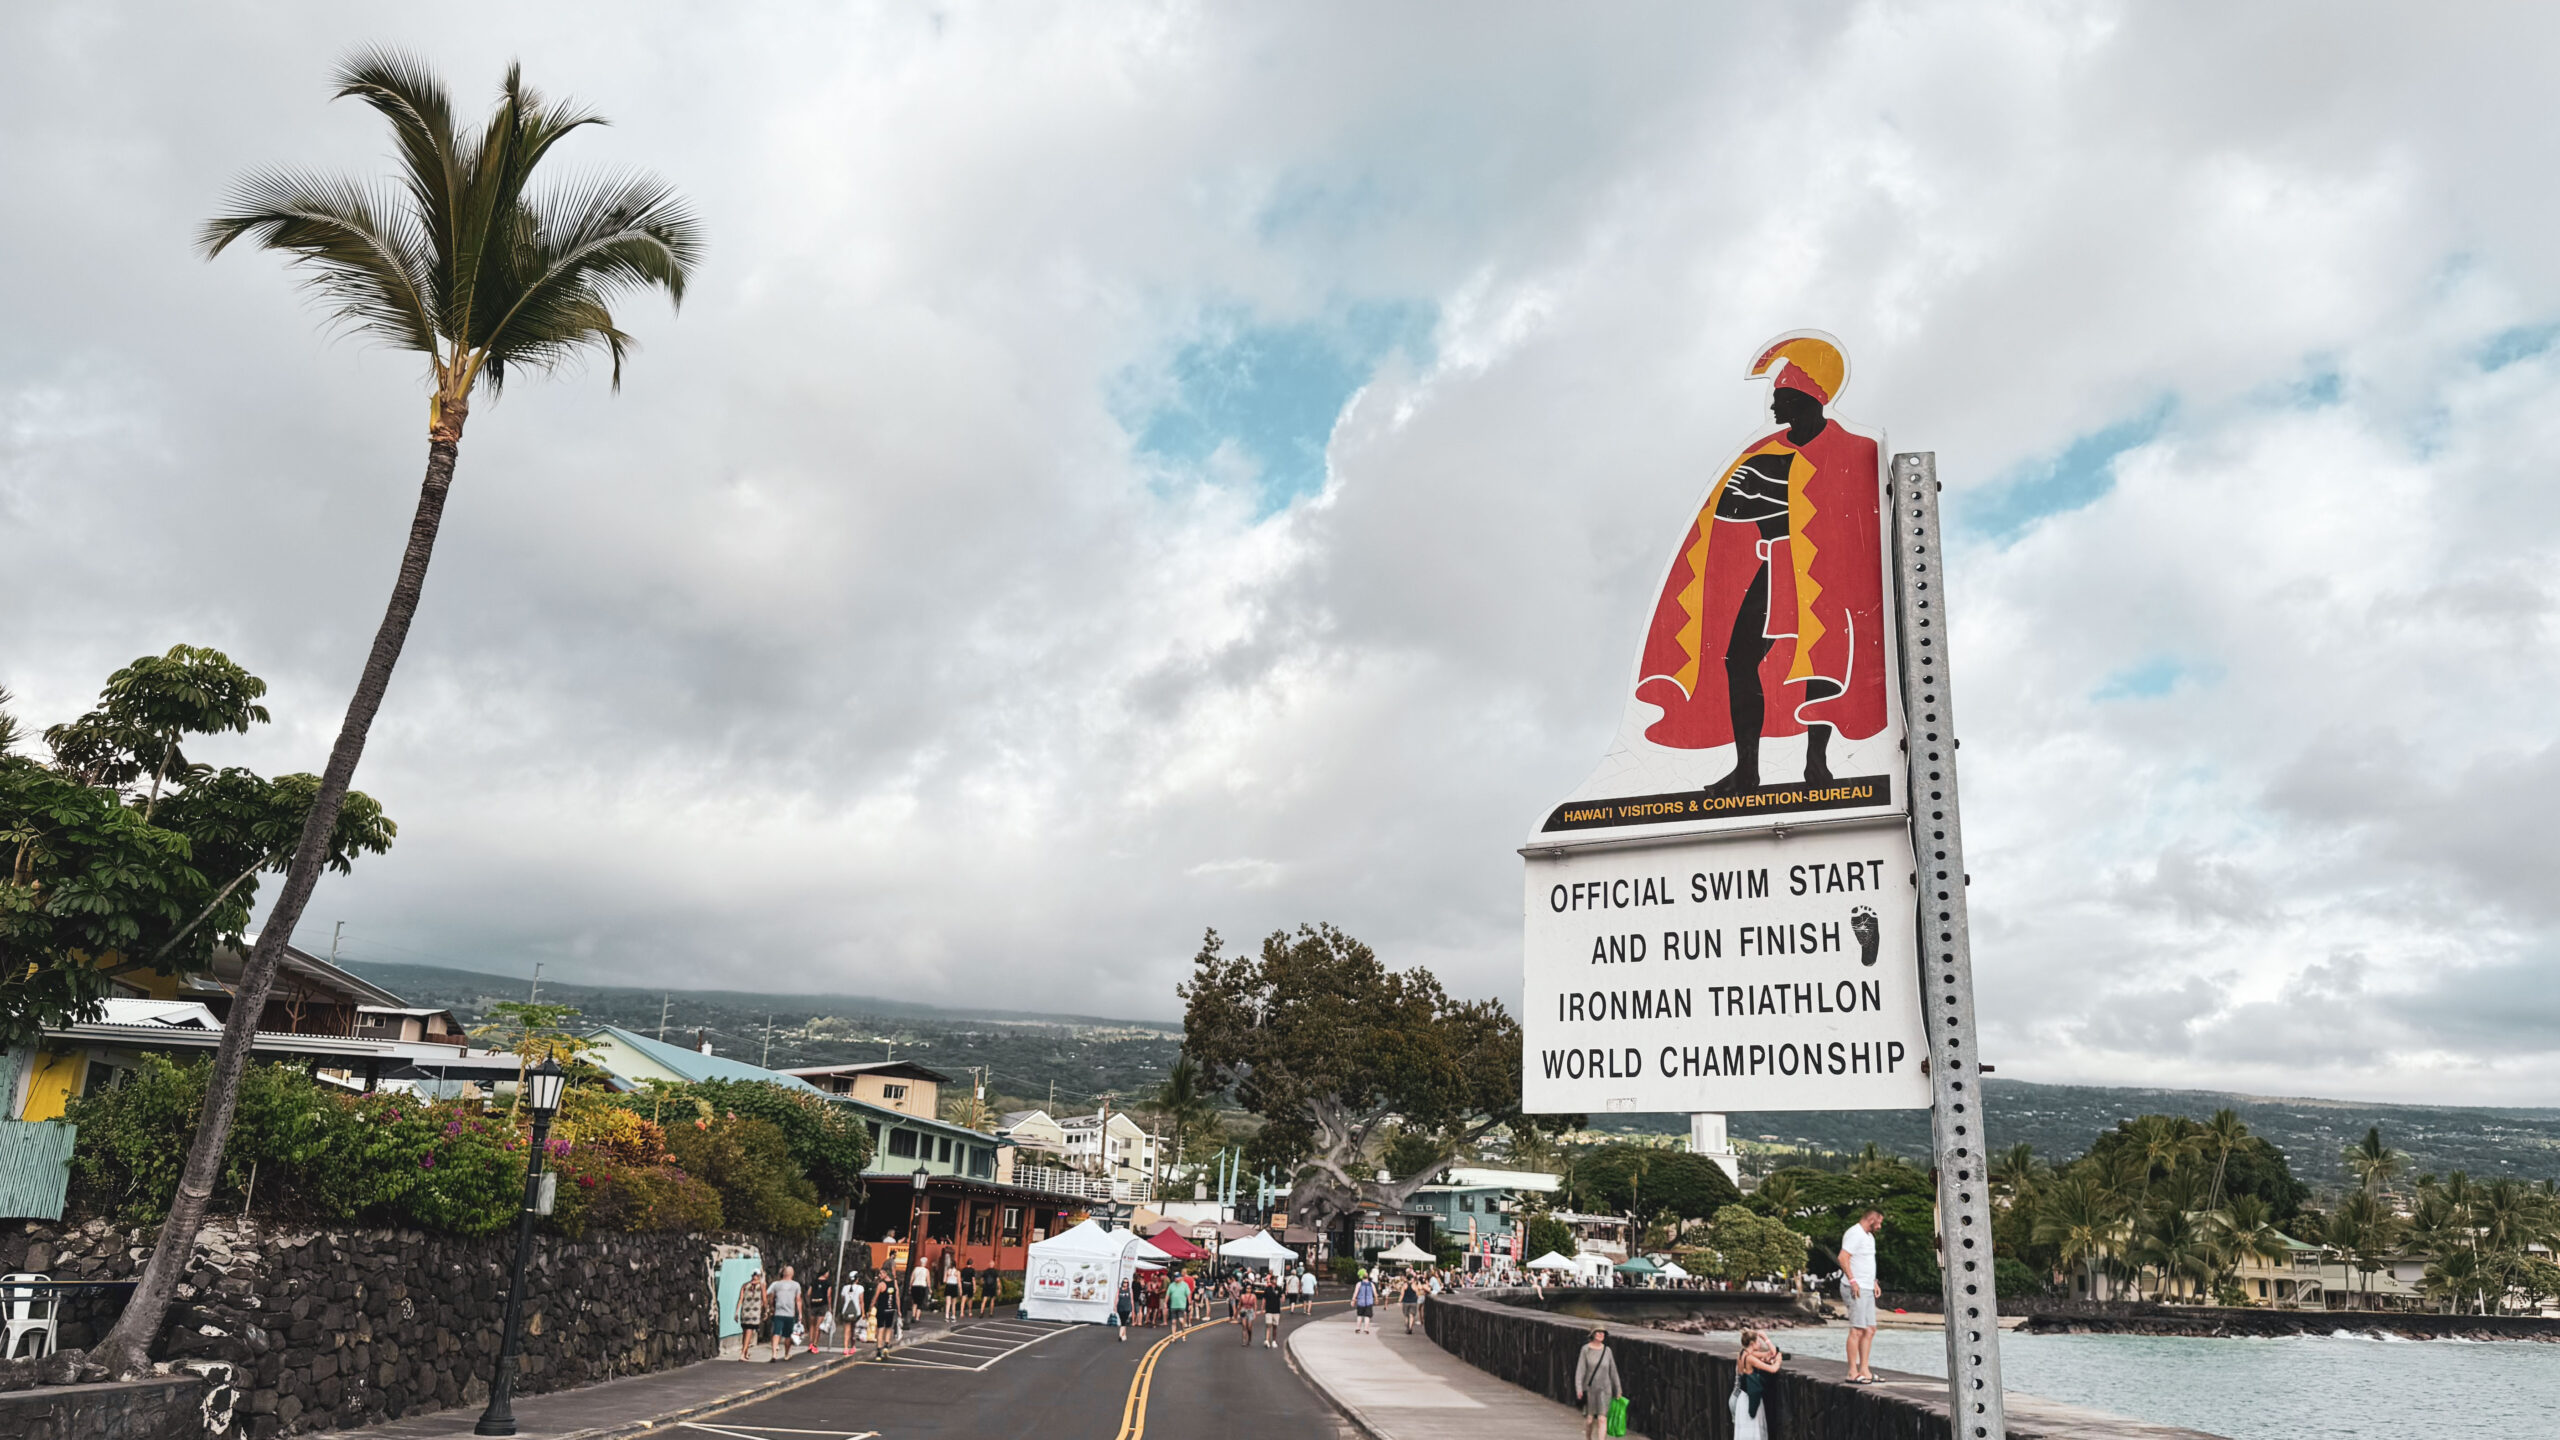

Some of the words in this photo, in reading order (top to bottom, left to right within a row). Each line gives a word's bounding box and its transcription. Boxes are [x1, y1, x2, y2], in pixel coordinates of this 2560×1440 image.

[1618, 801, 1684, 818] VISITORS
[1689, 800, 1698, 812] &
[1551, 876, 1675, 912] OFFICIAL
[1691, 869, 1769, 903] SWIM
[1790, 860, 1884, 896] START
[1592, 934, 1647, 965] AND
[1664, 929, 1722, 961] RUN
[1741, 921, 1841, 957] FINISH
[1560, 989, 1692, 1022] IRONMAN
[1709, 980, 1881, 1017] TRIATHLON
[1543, 1048, 1642, 1080] WORLD
[1660, 1041, 1905, 1078] CHAMPIONSHIP
